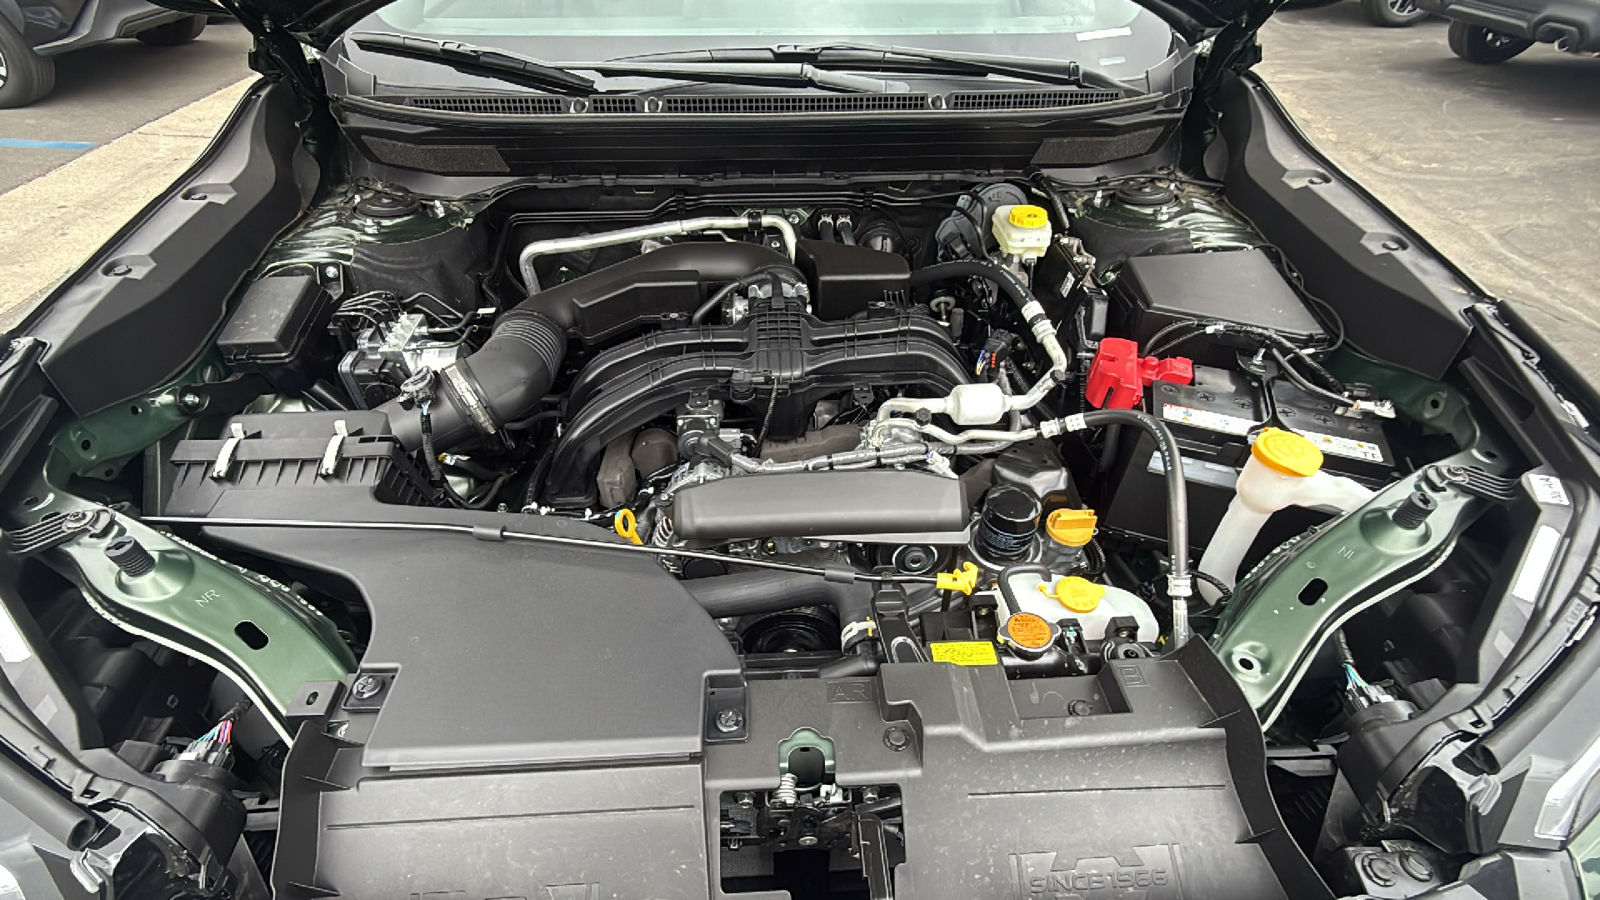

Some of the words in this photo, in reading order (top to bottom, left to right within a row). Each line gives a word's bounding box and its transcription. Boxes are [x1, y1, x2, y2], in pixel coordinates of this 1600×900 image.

[195, 590, 220, 608] NR
[831, 683, 869, 701] AR
[1029, 873, 1105, 894] SINCE
[1107, 869, 1168, 889] 1966
